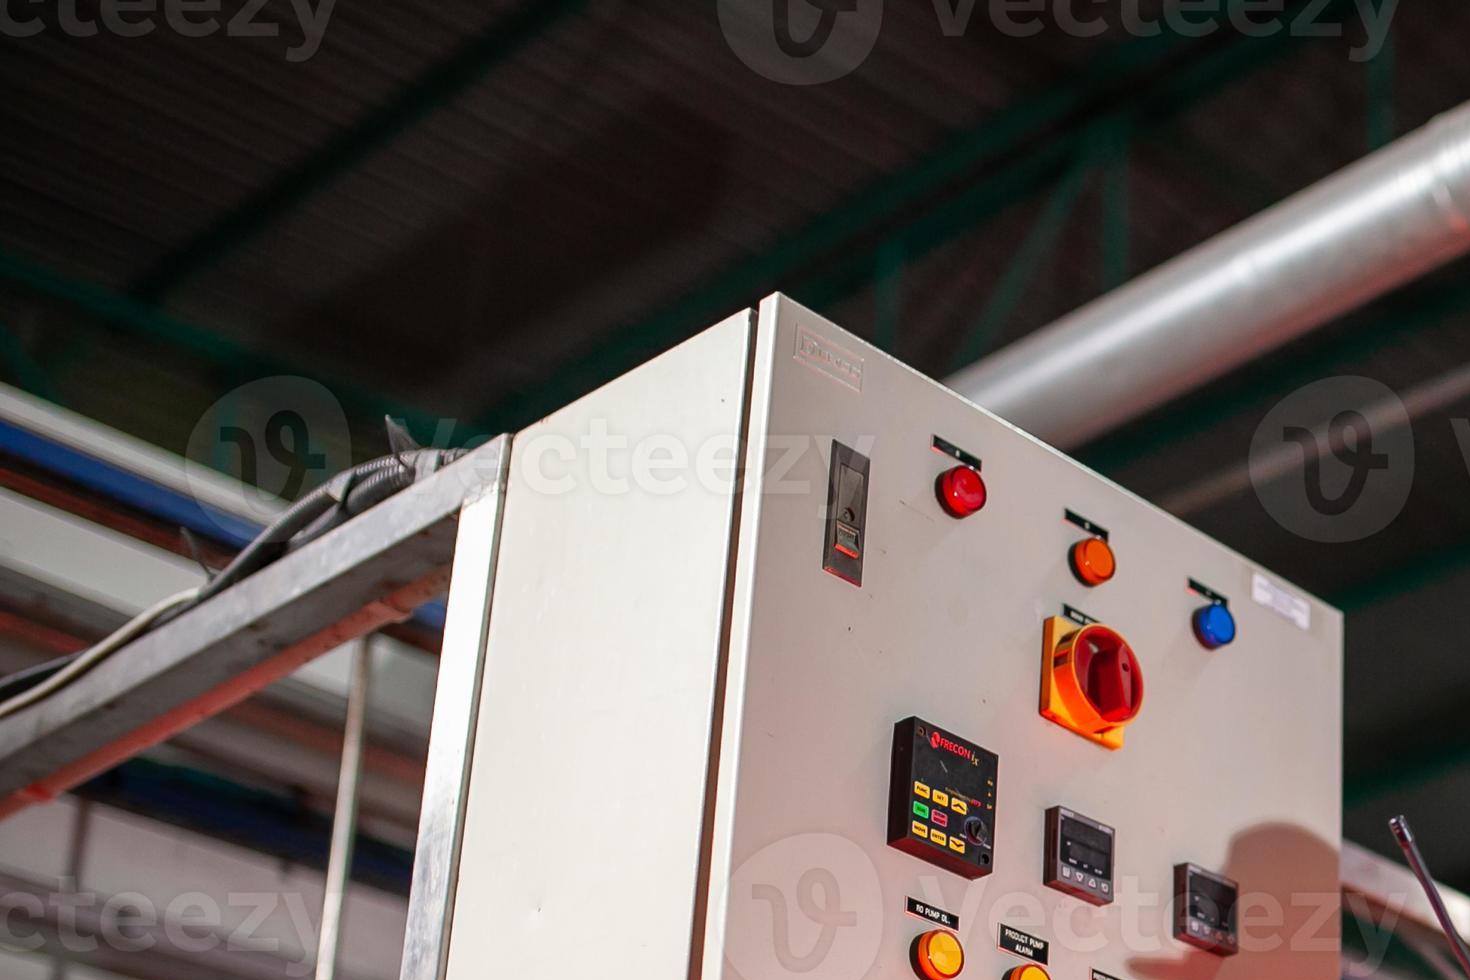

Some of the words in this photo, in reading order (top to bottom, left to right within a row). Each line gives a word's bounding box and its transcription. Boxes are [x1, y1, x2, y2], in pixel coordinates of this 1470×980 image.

[940, 737, 971, 760] FRECON
[925, 907, 940, 920] PUMP
[1005, 928, 1029, 943] PRODUCT
[1029, 937, 1044, 949] PUMP
[1015, 945, 1033, 957] ALARM
